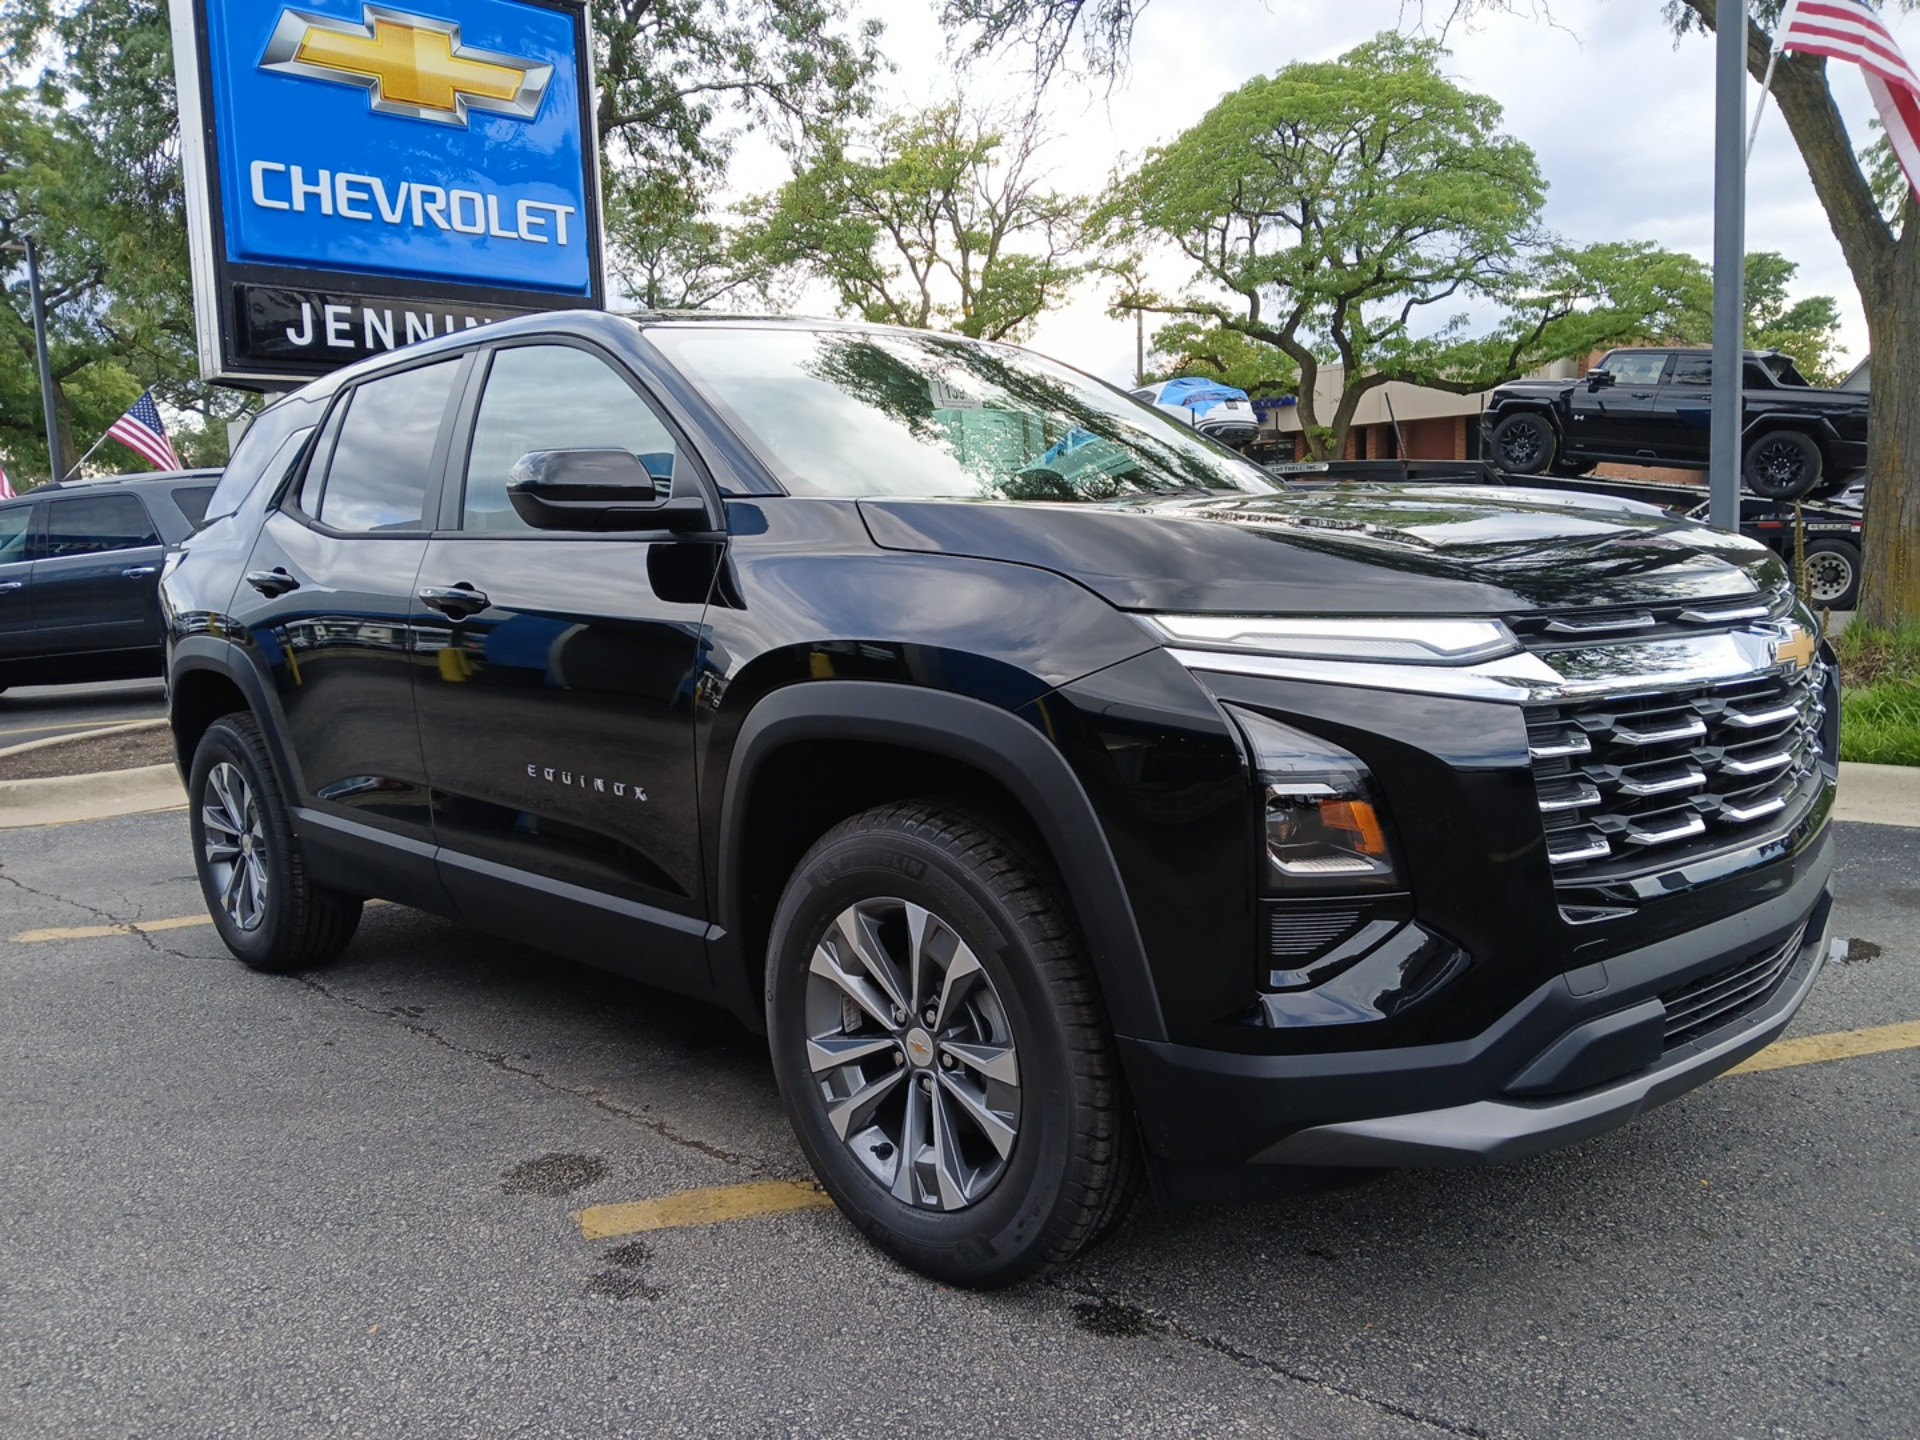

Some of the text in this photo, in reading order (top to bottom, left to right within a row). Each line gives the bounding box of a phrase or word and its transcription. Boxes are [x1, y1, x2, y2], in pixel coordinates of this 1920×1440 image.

[250, 160, 575, 245] CHEVROLET
[286, 302, 491, 350] JENN
[527, 763, 648, 802] EQUINOX
